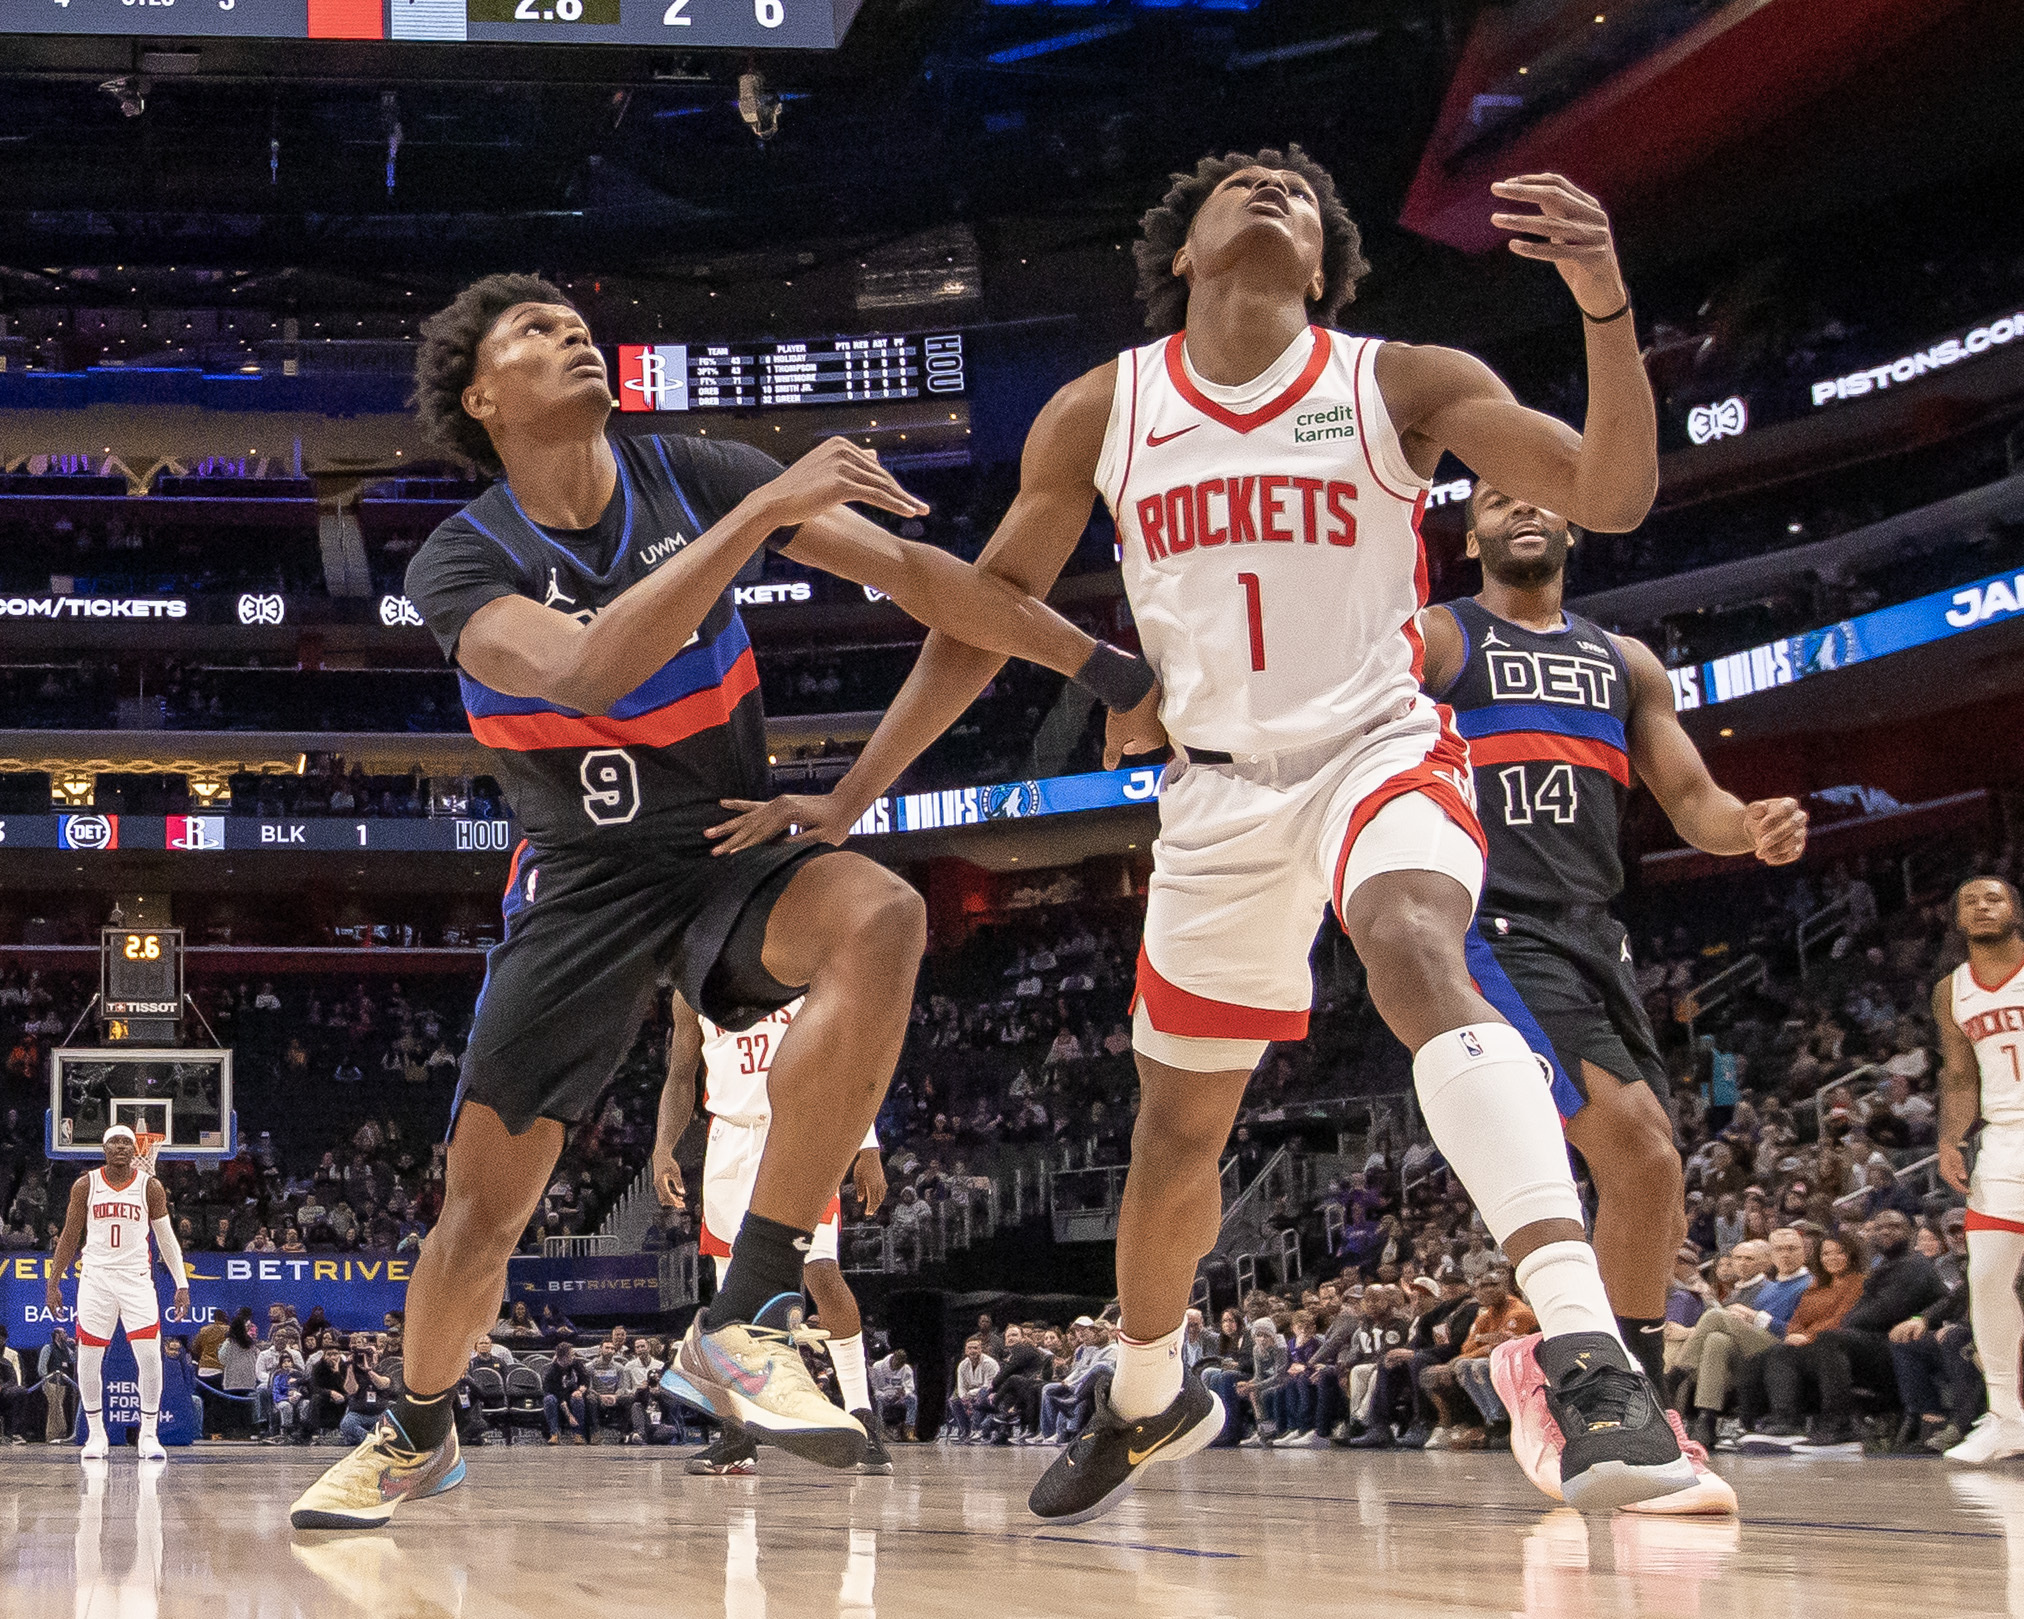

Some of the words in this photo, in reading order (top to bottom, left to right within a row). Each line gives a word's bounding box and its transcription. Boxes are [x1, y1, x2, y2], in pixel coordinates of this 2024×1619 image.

[707, 347, 729, 356] TEAM
[776, 344, 807, 354] PLAYER
[925, 335, 964, 393] HOU
[774, 384, 799, 393] SMITH
[1296, 405, 1354, 426] credit
[1294, 424, 1355, 443] karma
[1136, 475, 1359, 563] ROCKETS
[640, 532, 687, 566] UWM
[734, 582, 811, 604] KETS
[1237, 571, 1266, 672] 1
[1486, 651, 1616, 709] DET
[580, 749, 640, 825] 9
[1499, 765, 1578, 826] 14
[74, 825, 103, 840] DET
[261, 825, 305, 844] BLK
[357, 824, 367, 845] 1
[457, 820, 509, 850] HOU
[125, 934, 160, 960] 2.6
[126, 1002, 178, 1013] TISSOT
[736, 1033, 769, 1075] 32
[2001, 1045, 2020, 1083] 7
[93, 1202, 141, 1222] ROCKETS
[111, 1224, 120, 1248] 0
[227, 1259, 410, 1281] BETRIVE
[548, 1278, 659, 1292] BETRIVERS
[107, 1381, 140, 1394] HEN
[109, 1396, 140, 1408] FOR
[109, 1410, 173, 1423] HEAH
